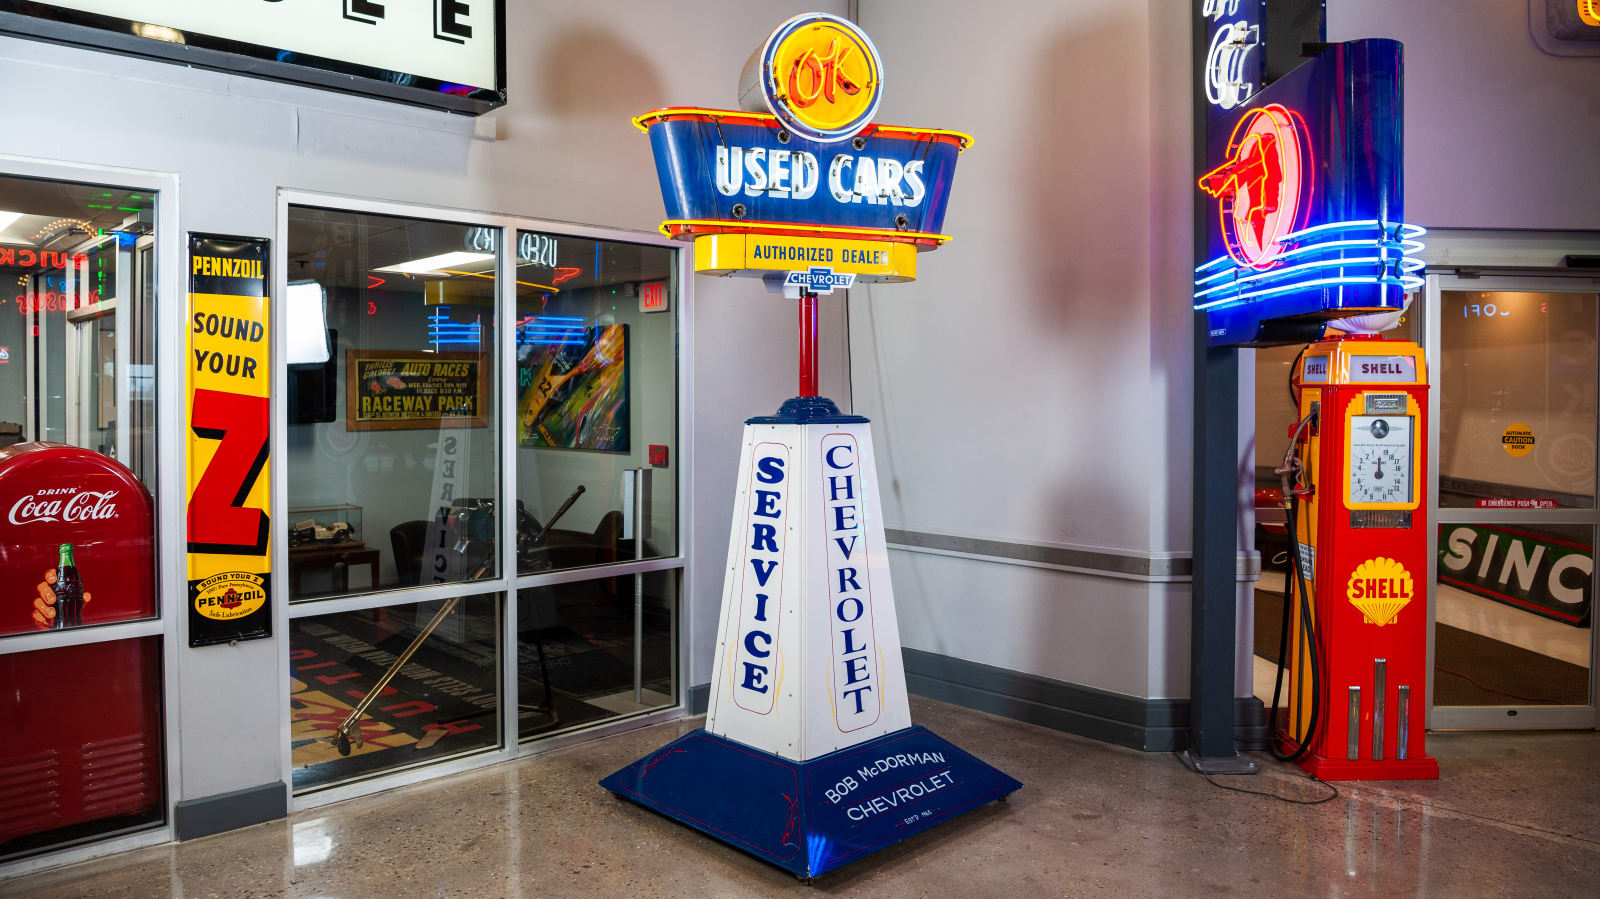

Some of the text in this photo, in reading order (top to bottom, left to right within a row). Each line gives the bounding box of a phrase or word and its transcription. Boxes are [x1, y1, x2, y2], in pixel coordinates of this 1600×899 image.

[788, 36, 860, 109] OK
[716, 145, 926, 208] USED CARS
[753, 244, 889, 266] AUTHORIZED DEALER
[192, 255, 265, 280] PENNZOIL
[790, 273, 852, 286] CHEVROLET
[644, 283, 663, 308] EXIT
[193, 312, 264, 343] SOUND
[194, 349, 258, 379] YOUR
[401, 363, 470, 376] AUTO RACES
[1307, 364, 1327, 375] SHELL
[1361, 363, 1403, 374] SHELL
[362, 396, 473, 412] RACEWAY PARK
[186, 388, 270, 556] Z
[37, 487, 78, 496] DRINK
[1488, 499, 1516, 507] EMERGENCY
[200, 574, 228, 589] SOUND
[230, 573, 251, 581] YOUR
[741, 456, 785, 695] SERVICE
[825, 445, 872, 715] CHEVROLET
[199, 590, 263, 608] PENNZOIL
[1352, 578, 1410, 599] SHELL
[209, 606, 253, 618] Safe Lubrication
[824, 752, 946, 805] BOB McDORMAN
[847, 770, 955, 821] CHEVROLET
